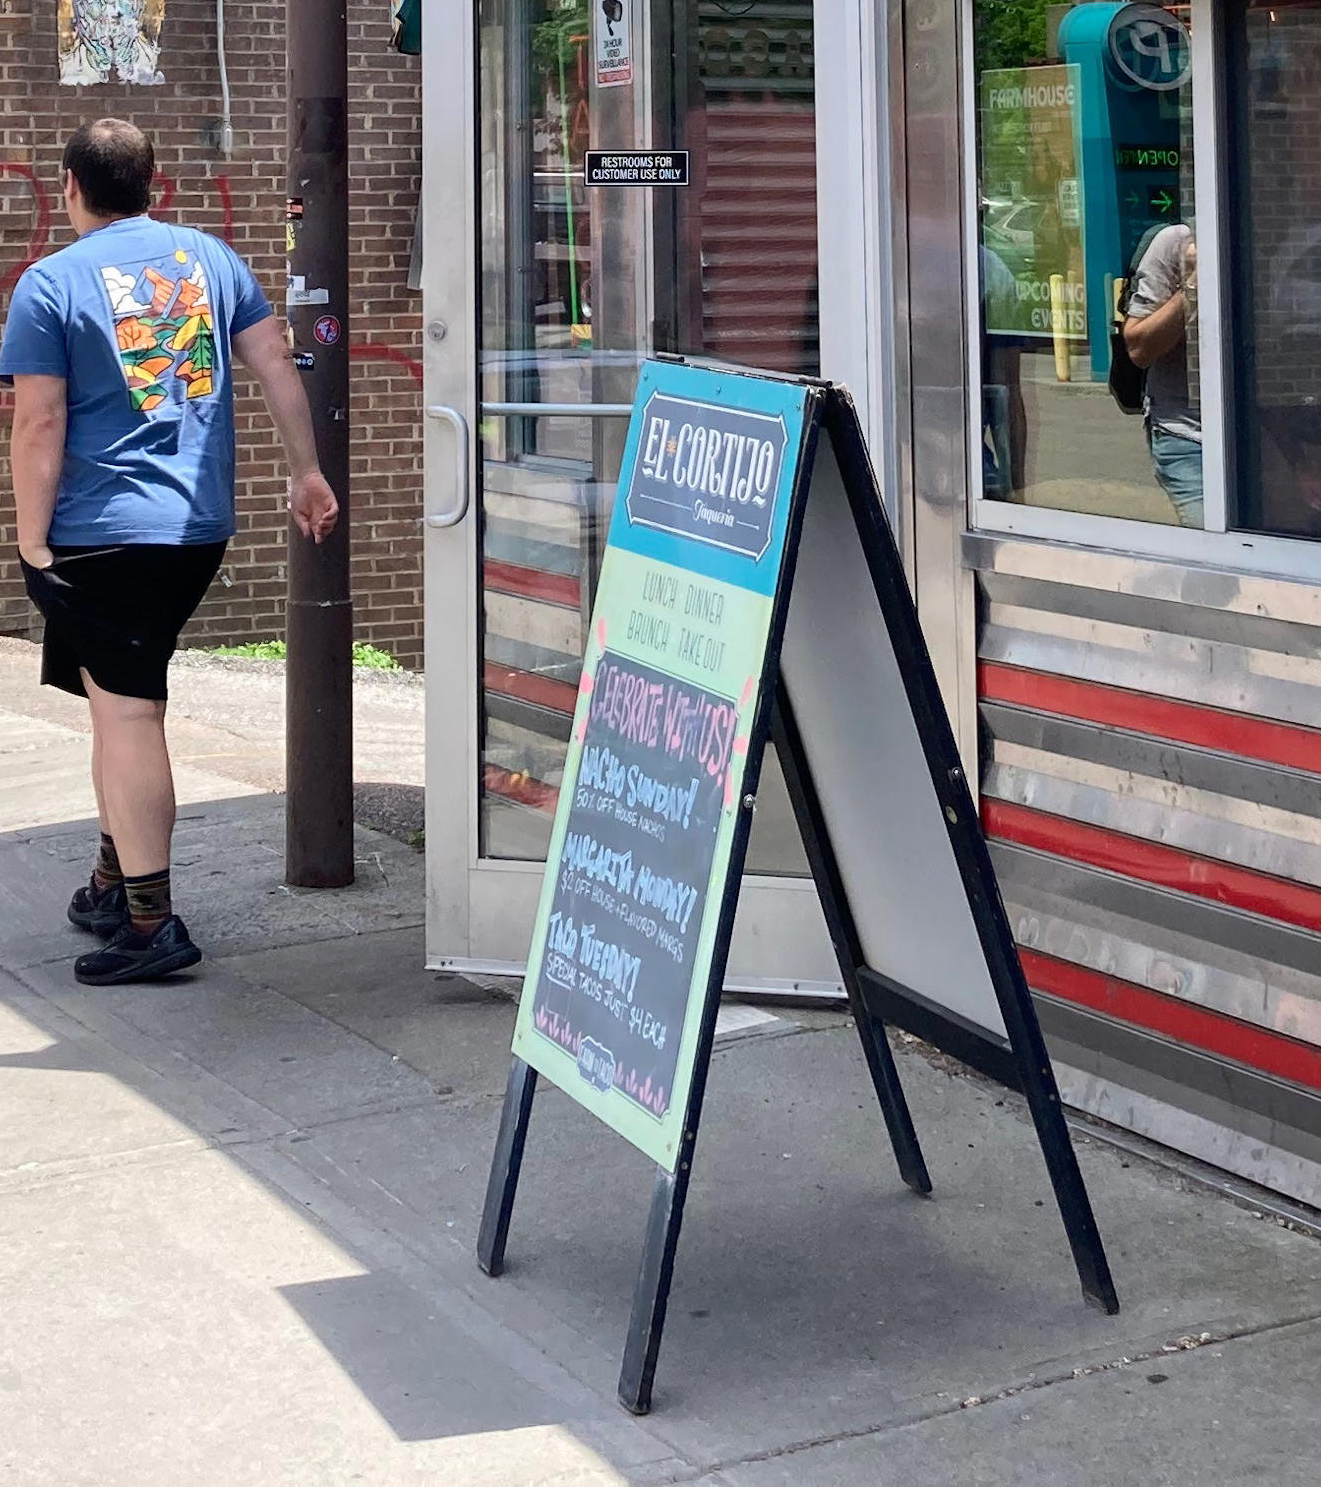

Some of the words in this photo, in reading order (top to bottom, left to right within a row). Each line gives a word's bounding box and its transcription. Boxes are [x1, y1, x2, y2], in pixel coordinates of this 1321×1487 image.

[989, 84, 1075, 109] FARMHOUSE
[592, 169, 638, 180] CUSTOMER
[640, 169, 657, 180] USE
[659, 168, 681, 180] ONLY
[601, 156, 653, 168] RESTROOMS
[655, 156, 672, 167] FOR
[643, 416, 671, 480] EL
[673, 423, 774, 502] CORTIJO
[693, 499, 735, 527] Taqueria
[642, 572, 678, 610] LUNCH
[684, 584, 724, 626] DINNER
[627, 610, 670, 652] BRUNCH
[678, 628, 703, 667] TAKE
[703, 637, 726, 673] OUT
[591, 661, 664, 749] CELEBRATE
[662, 684, 704, 762] WITH
[698, 700, 737, 787] US!
[576, 789, 595, 808] 50%
[596, 793, 615, 813] OFF
[615, 802, 638, 827] HOUSE
[579, 745, 626, 799] NACHO
[627, 764, 700, 830] SUNDAY!
[560, 869, 574, 896] $2
[574, 877, 592, 899] OFF
[592, 884, 616, 914] HOUSE
[562, 831, 635, 895] MARGARITA
[633, 865, 698, 933] MONDAY!
[547, 911, 578, 959] TACO
[579, 921, 642, 1003] TUESDAY!
[546, 954, 576, 987] SPECIAL
[578, 971, 603, 1002] TACOS
[603, 989, 629, 1021] JUST
[629, 1005, 644, 1034] $4
[642, 1012, 668, 1050] EACH
